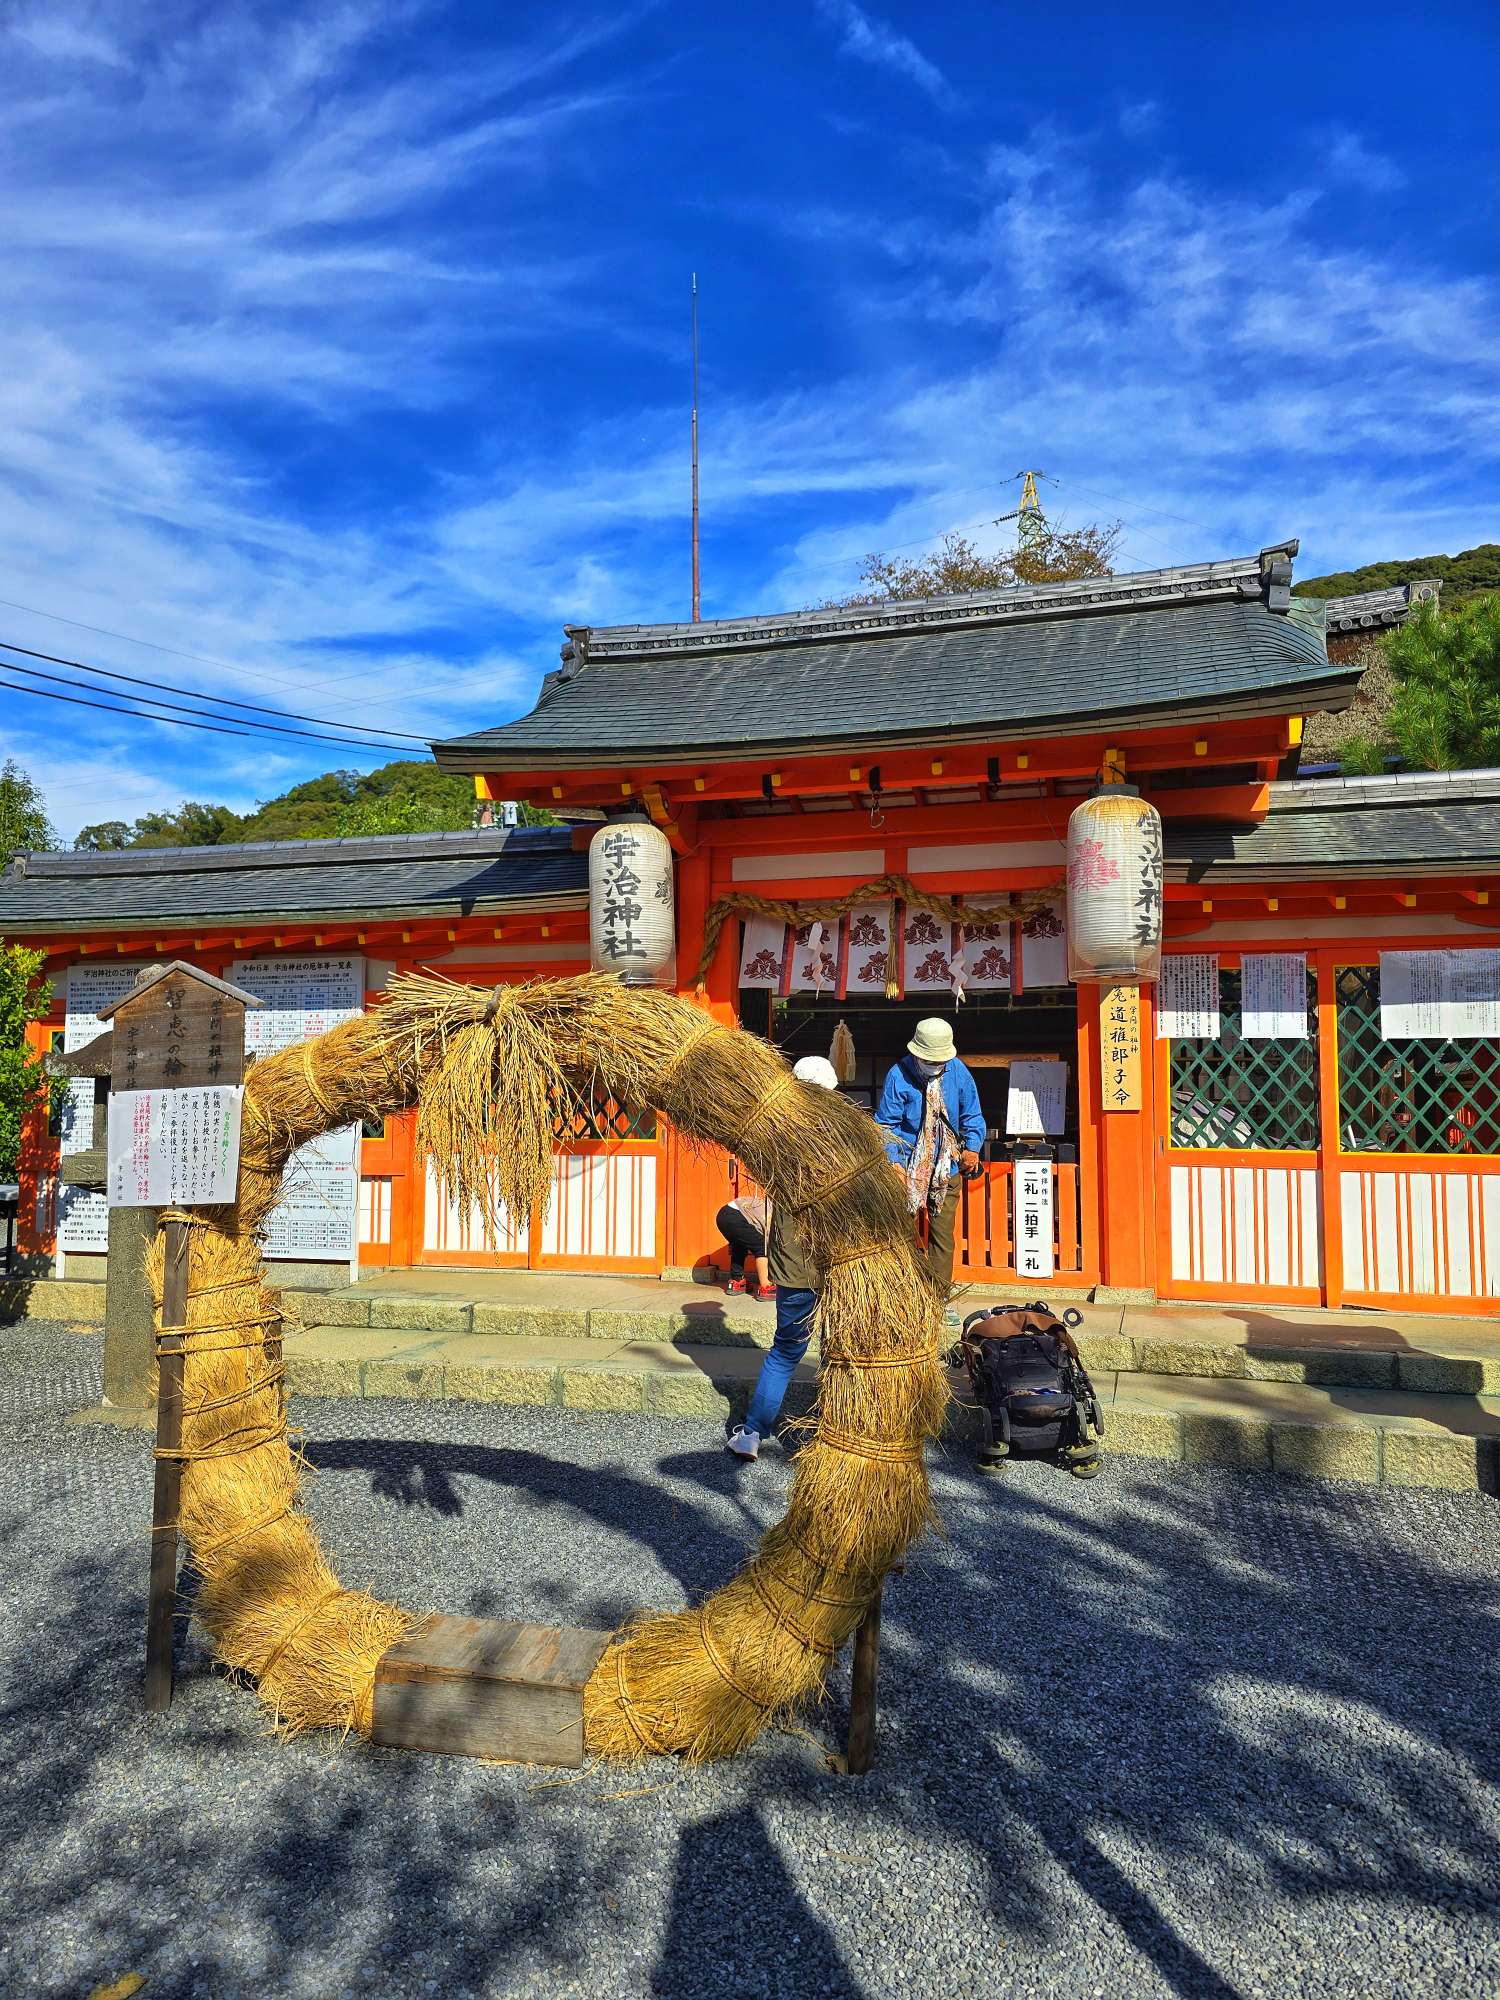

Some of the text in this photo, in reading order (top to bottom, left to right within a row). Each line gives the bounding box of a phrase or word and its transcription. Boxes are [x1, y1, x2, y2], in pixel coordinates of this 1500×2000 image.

[601, 832, 648, 961] 宇治神社
[126, 1026, 139, 1089] 宇治神社
[162, 988, 187, 1078] 智恵の輪
[1024, 1171, 1040, 1270] 二礼 二拍手 一礼
